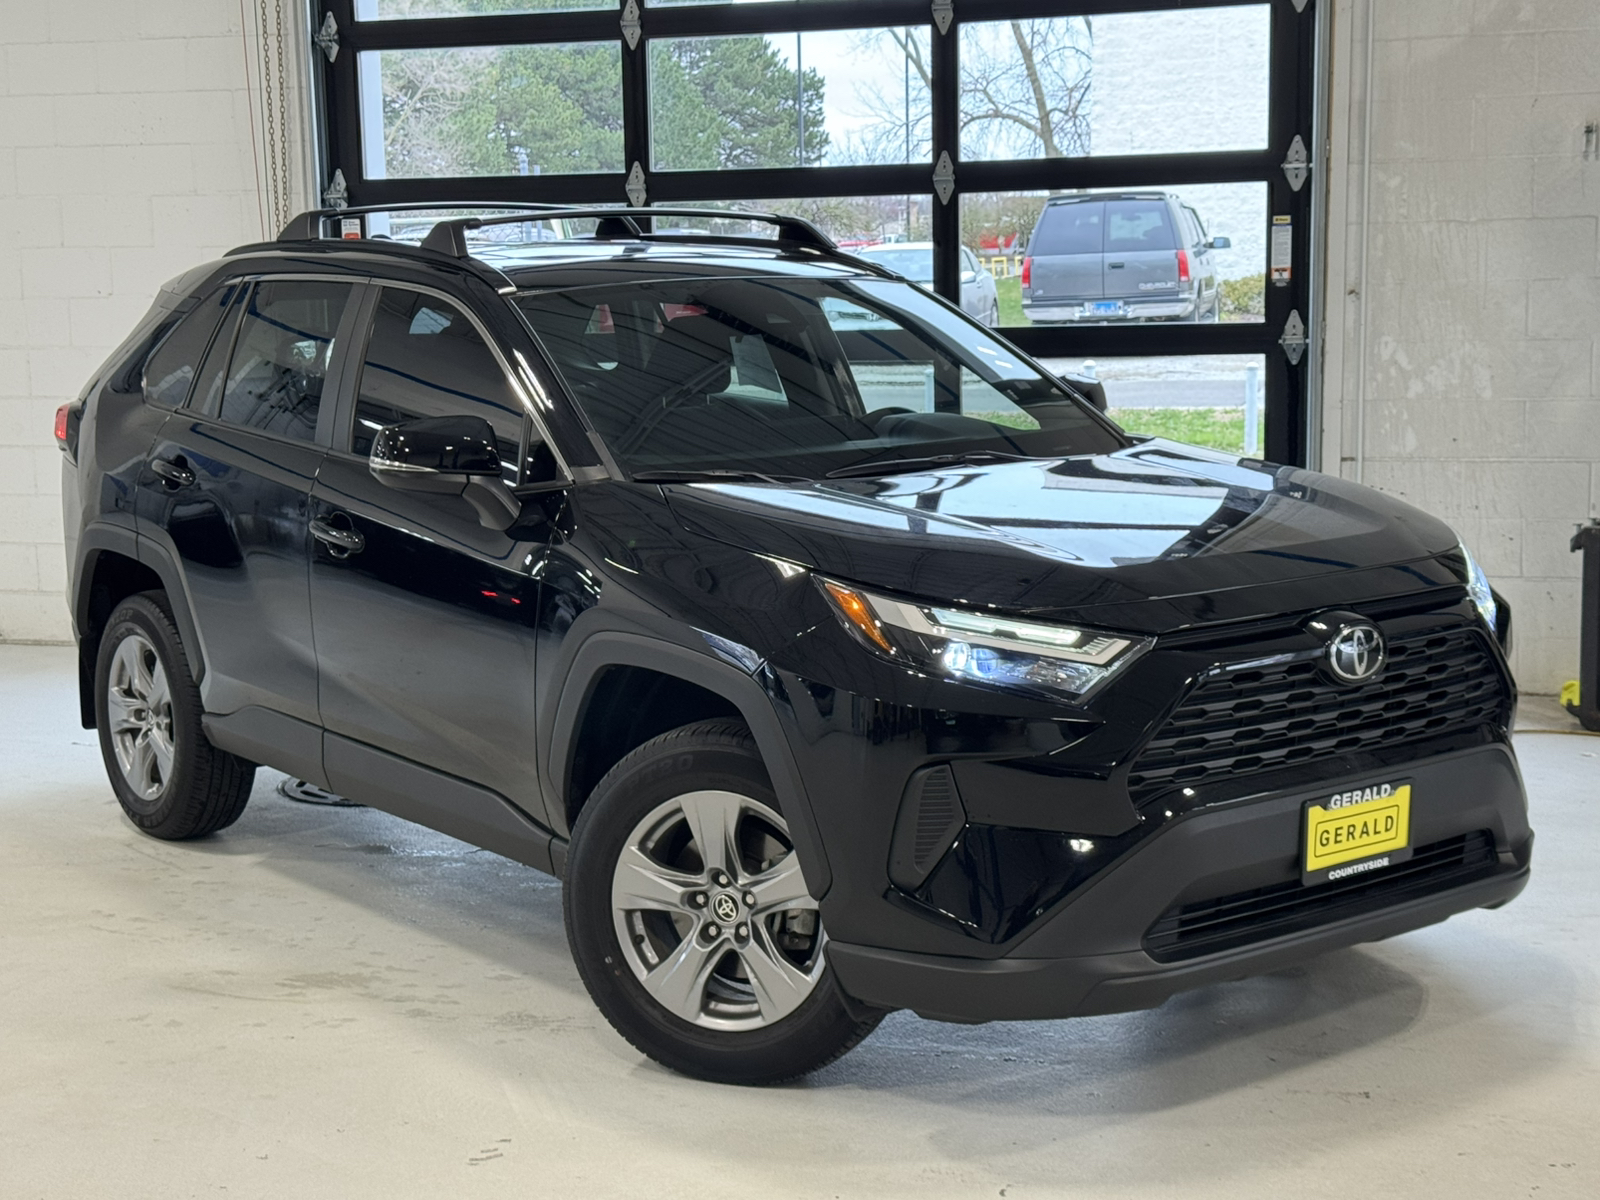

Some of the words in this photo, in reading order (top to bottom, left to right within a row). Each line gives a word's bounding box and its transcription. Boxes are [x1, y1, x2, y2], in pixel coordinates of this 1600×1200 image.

[1330, 784, 1391, 809] GERALD
[1319, 815, 1395, 847] GERALD
[1328, 857, 1390, 880] COUNTRYSIDE
